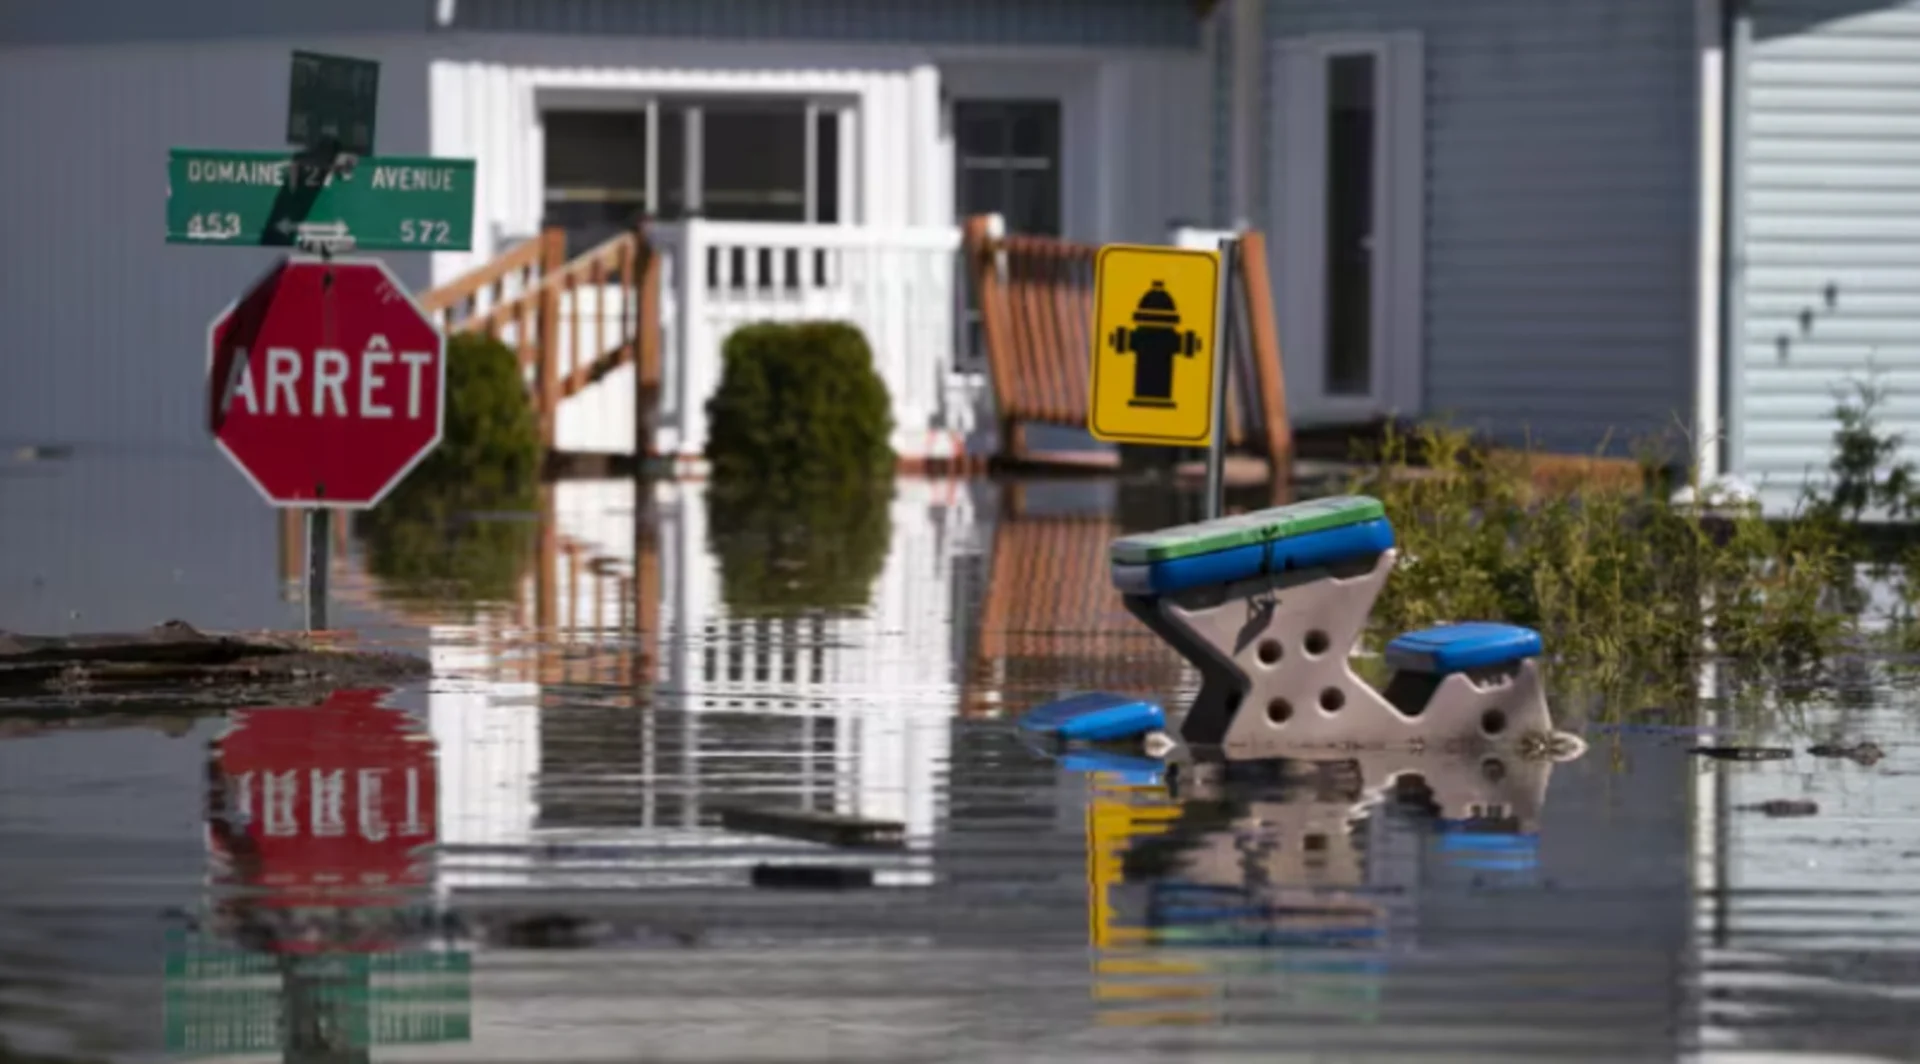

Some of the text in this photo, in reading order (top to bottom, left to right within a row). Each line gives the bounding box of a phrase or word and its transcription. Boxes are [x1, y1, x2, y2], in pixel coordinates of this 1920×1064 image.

[187, 159, 285, 187] DOMAINE
[371, 167, 454, 191] AVENUE
[187, 211, 242, 238] 453
[399, 219, 451, 244] 572
[220, 333, 433, 420] ARRÊT
